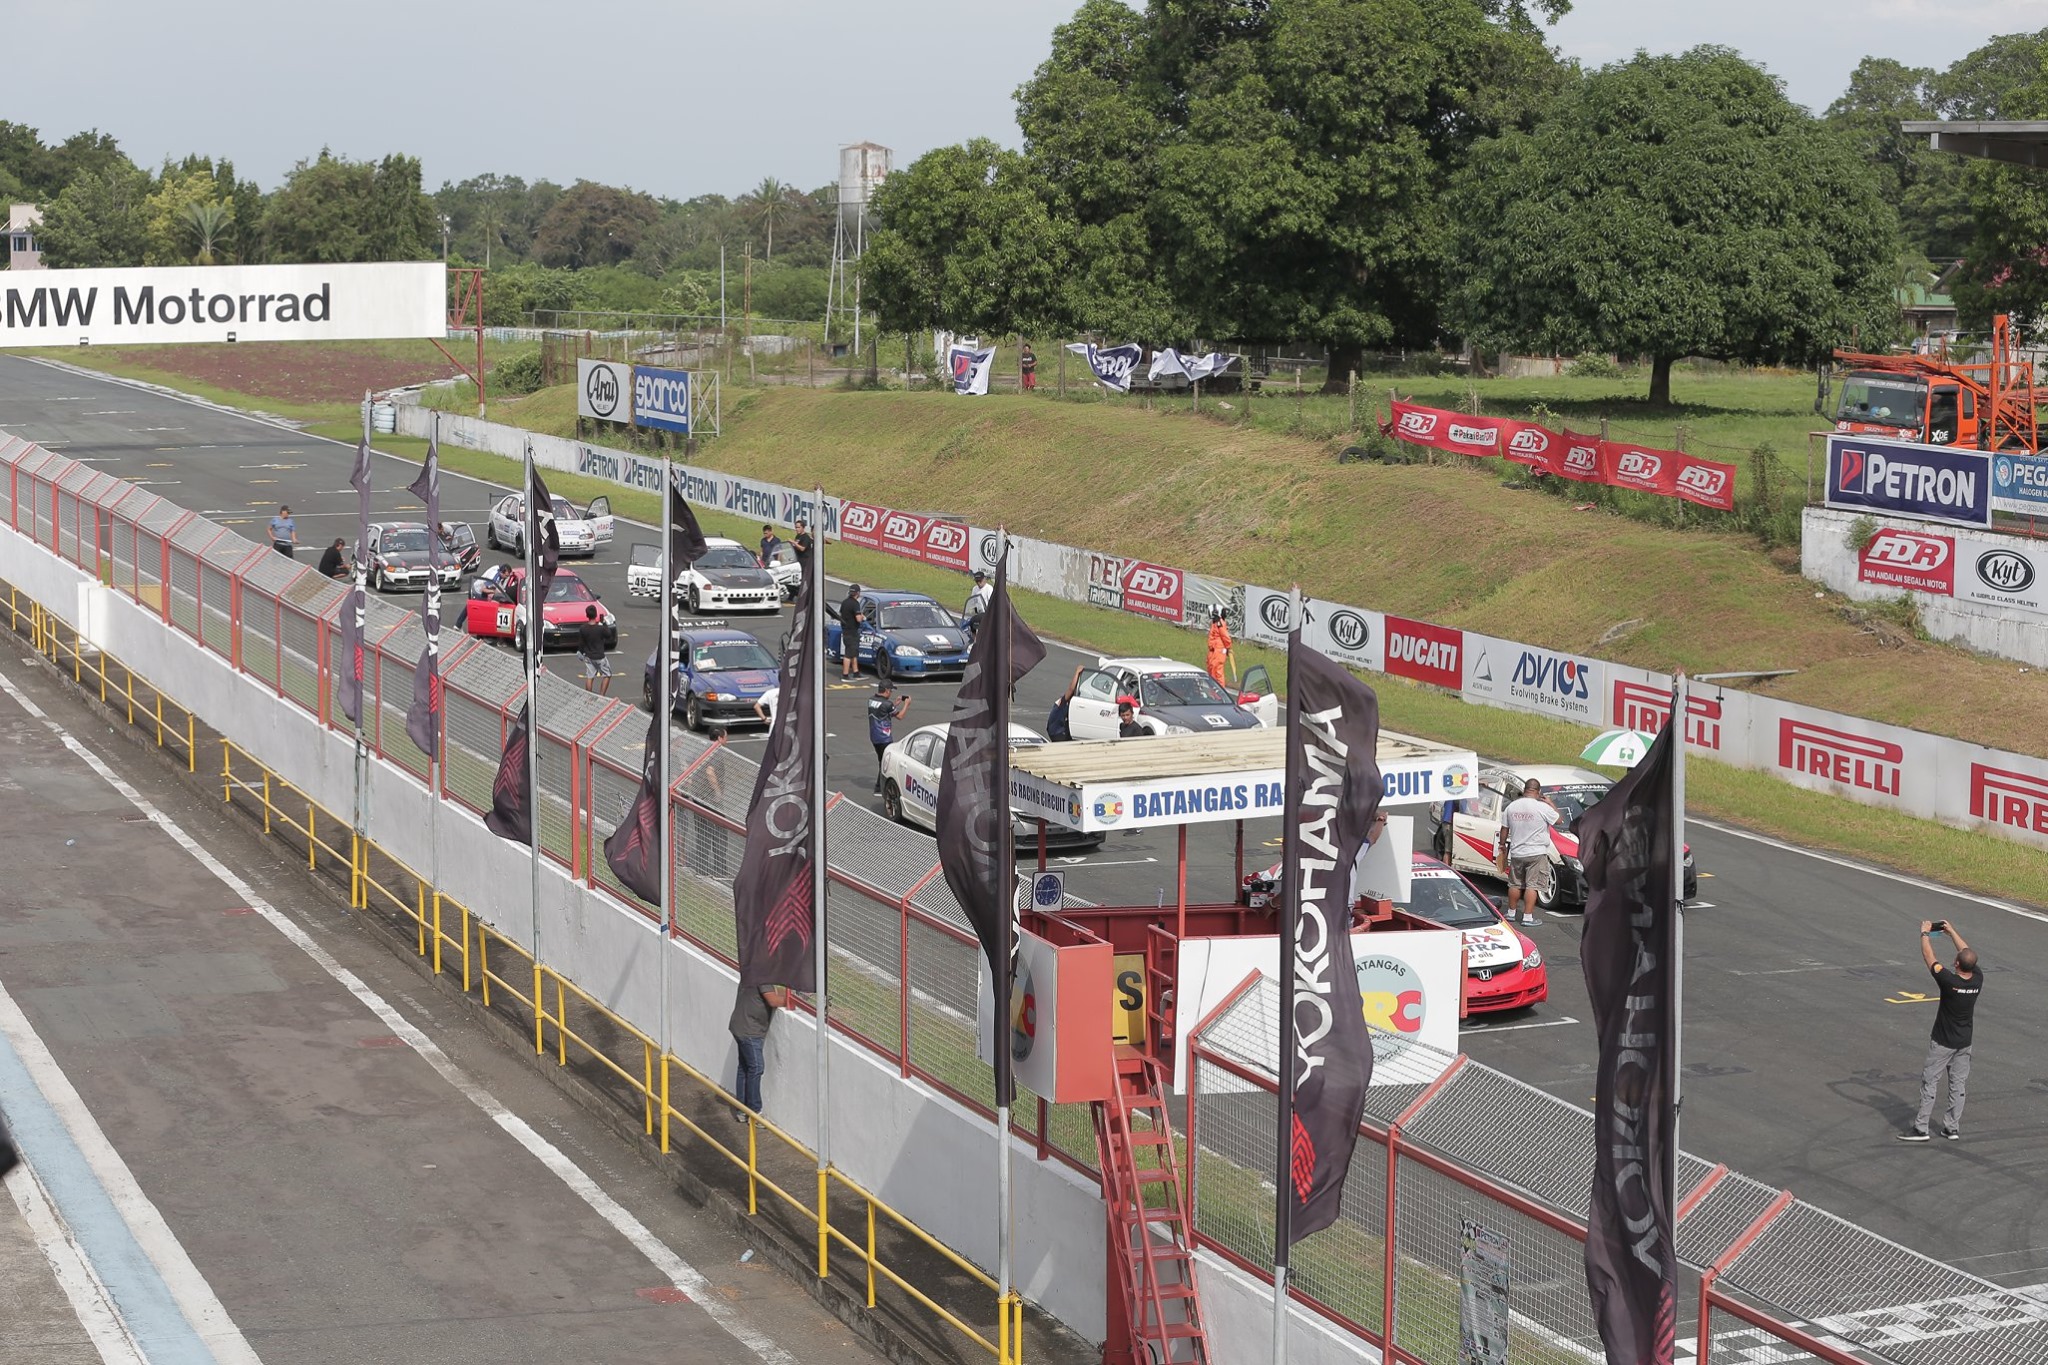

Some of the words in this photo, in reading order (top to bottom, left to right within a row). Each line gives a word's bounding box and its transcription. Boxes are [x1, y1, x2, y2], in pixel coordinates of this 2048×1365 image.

[0, 287, 98, 328] MW
[114, 283, 330, 325] Motorrad
[590, 370, 615, 402] Arai
[636, 375, 687, 419] sparco
[1400, 414, 1432, 431] FDR
[1932, 430, 1949, 442] XDE
[1510, 431, 1544, 450] FDR
[587, 448, 618, 481] PETRON
[1566, 448, 1595, 467] FDR
[1618, 453, 1658, 476] FDR
[679, 469, 717, 505] PETRON
[1677, 466, 1722, 492] FDR
[1866, 454, 1975, 509] PETRON
[734, 482, 776, 519] PETRON
[795, 495, 837, 534] PETON
[844, 508, 875, 529] FDR
[885, 517, 917, 539] FDR
[928, 526, 963, 550] FDR
[1868, 536, 1941, 567] FDR
[635, 578, 646, 587] 46
[1130, 569, 1174, 596] FDR
[1864, 569, 1876, 578] BAN
[1877, 572, 1903, 583] ANDALAN
[1904, 576, 1926, 587] SEGALA
[1927, 580, 1947, 590] MOTOR
[1992, 560, 2021, 585] Kyt
[1997, 596, 2016, 604] CLASS
[499, 614, 509, 626] 14
[1270, 604, 1288, 627] Kyt
[1339, 620, 1358, 644] Kyt
[1389, 632, 1457, 673] DUCATI
[1512, 651, 1589, 700] ADVICS
[1511, 686, 1539, 704] Evolving
[1540, 692, 1559, 707] Brake
[1560, 698, 1589, 714] Systems
[1614, 679, 1720, 750] PIRLLI
[1779, 717, 1903, 797] PIRELLI
[1384, 770, 1433, 797] CUIT
[1019, 782, 1040, 805] RACING
[1041, 791, 1066, 813] CIRCUIT
[1133, 786, 1248, 819] BATANGAS
[1294, 704, 1350, 1091] YOKOHAMA
[1462, 934, 1502, 945] LIX
[1467, 943, 1504, 953] TRA
[1356, 960, 1406, 977] ATANGAS
[1117, 971, 1143, 1011] S
[1360, 990, 1422, 1033] RC
